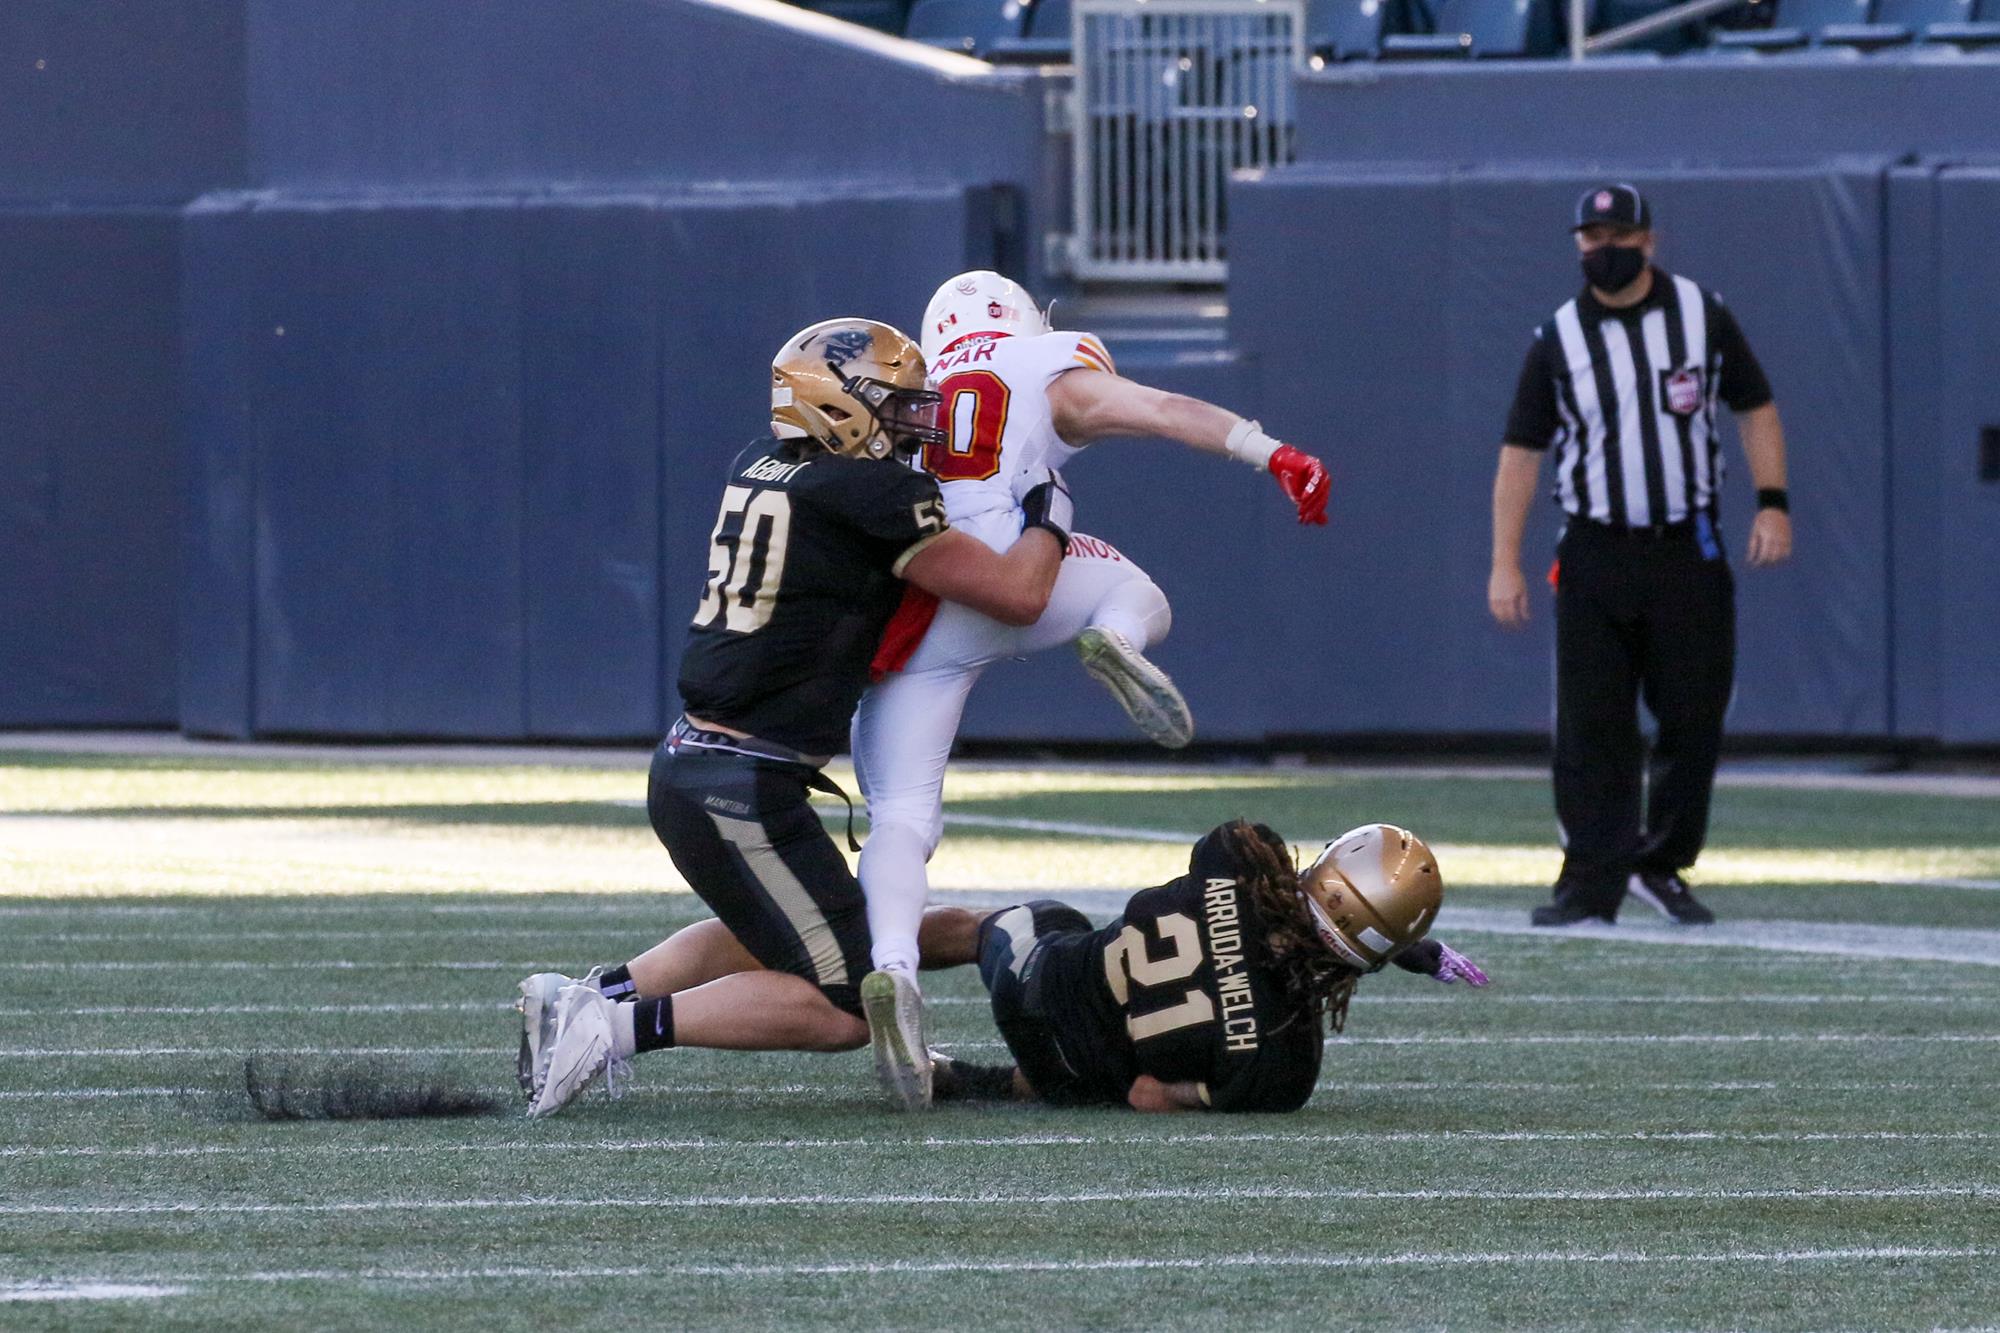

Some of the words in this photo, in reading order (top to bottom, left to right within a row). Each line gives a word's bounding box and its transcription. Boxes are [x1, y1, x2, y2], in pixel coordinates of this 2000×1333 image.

[692, 484, 791, 634] 50
[1104, 912, 1215, 1042] 21
[1206, 877, 1258, 1051] ARRUDA-WELCH
